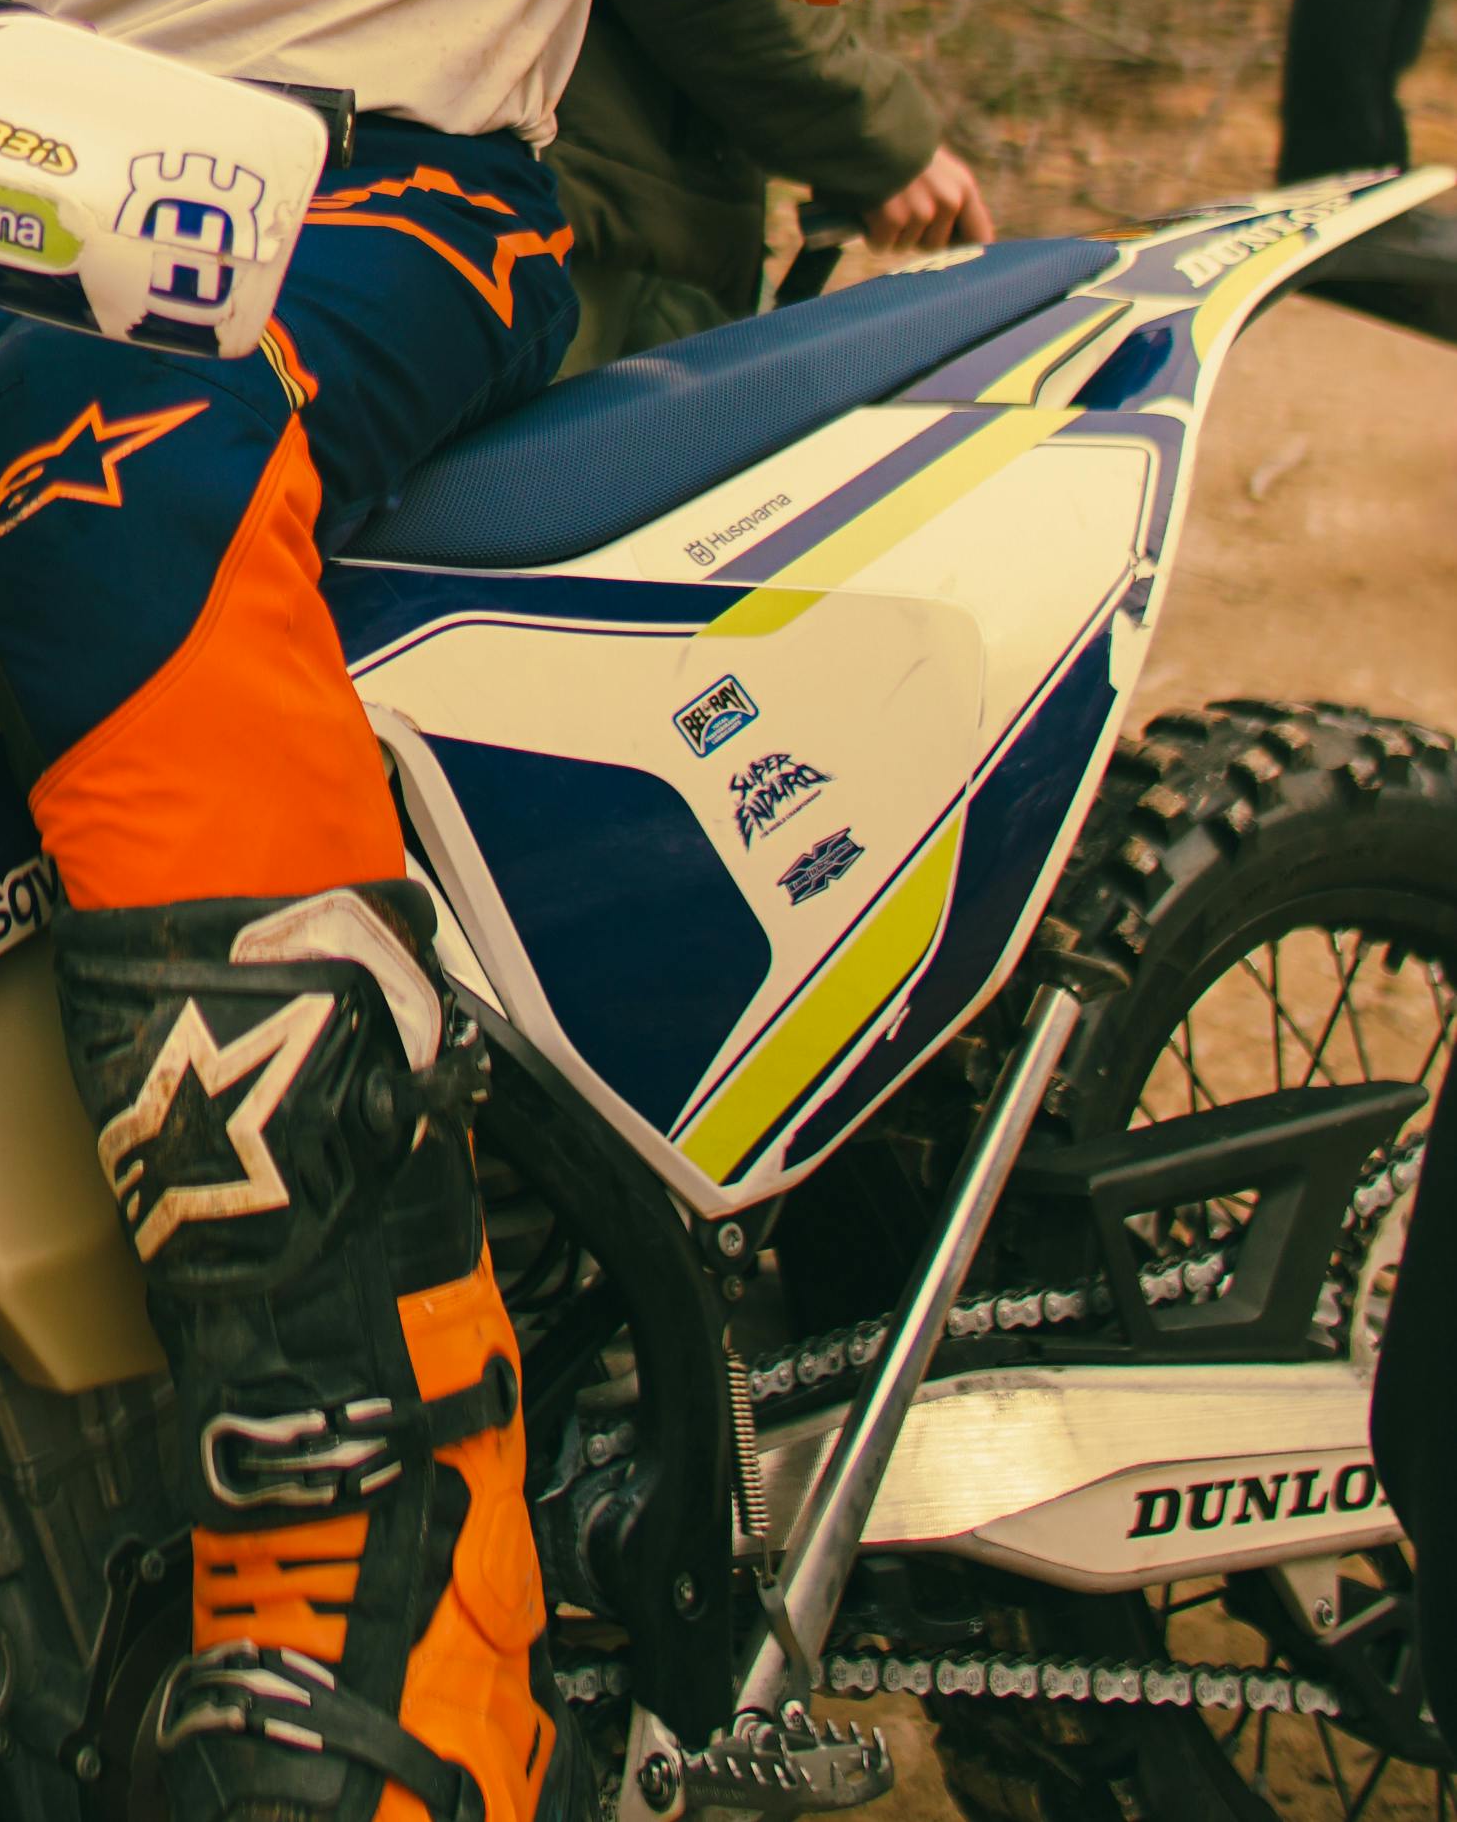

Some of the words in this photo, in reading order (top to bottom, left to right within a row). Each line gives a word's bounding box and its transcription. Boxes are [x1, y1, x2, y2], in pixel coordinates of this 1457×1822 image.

[705, 493, 792, 550] Husqvarna
[730, 754, 796, 800] SUPER
[734, 764, 835, 852] ENDURO
[1127, 1463, 1392, 1539] DUNLO
